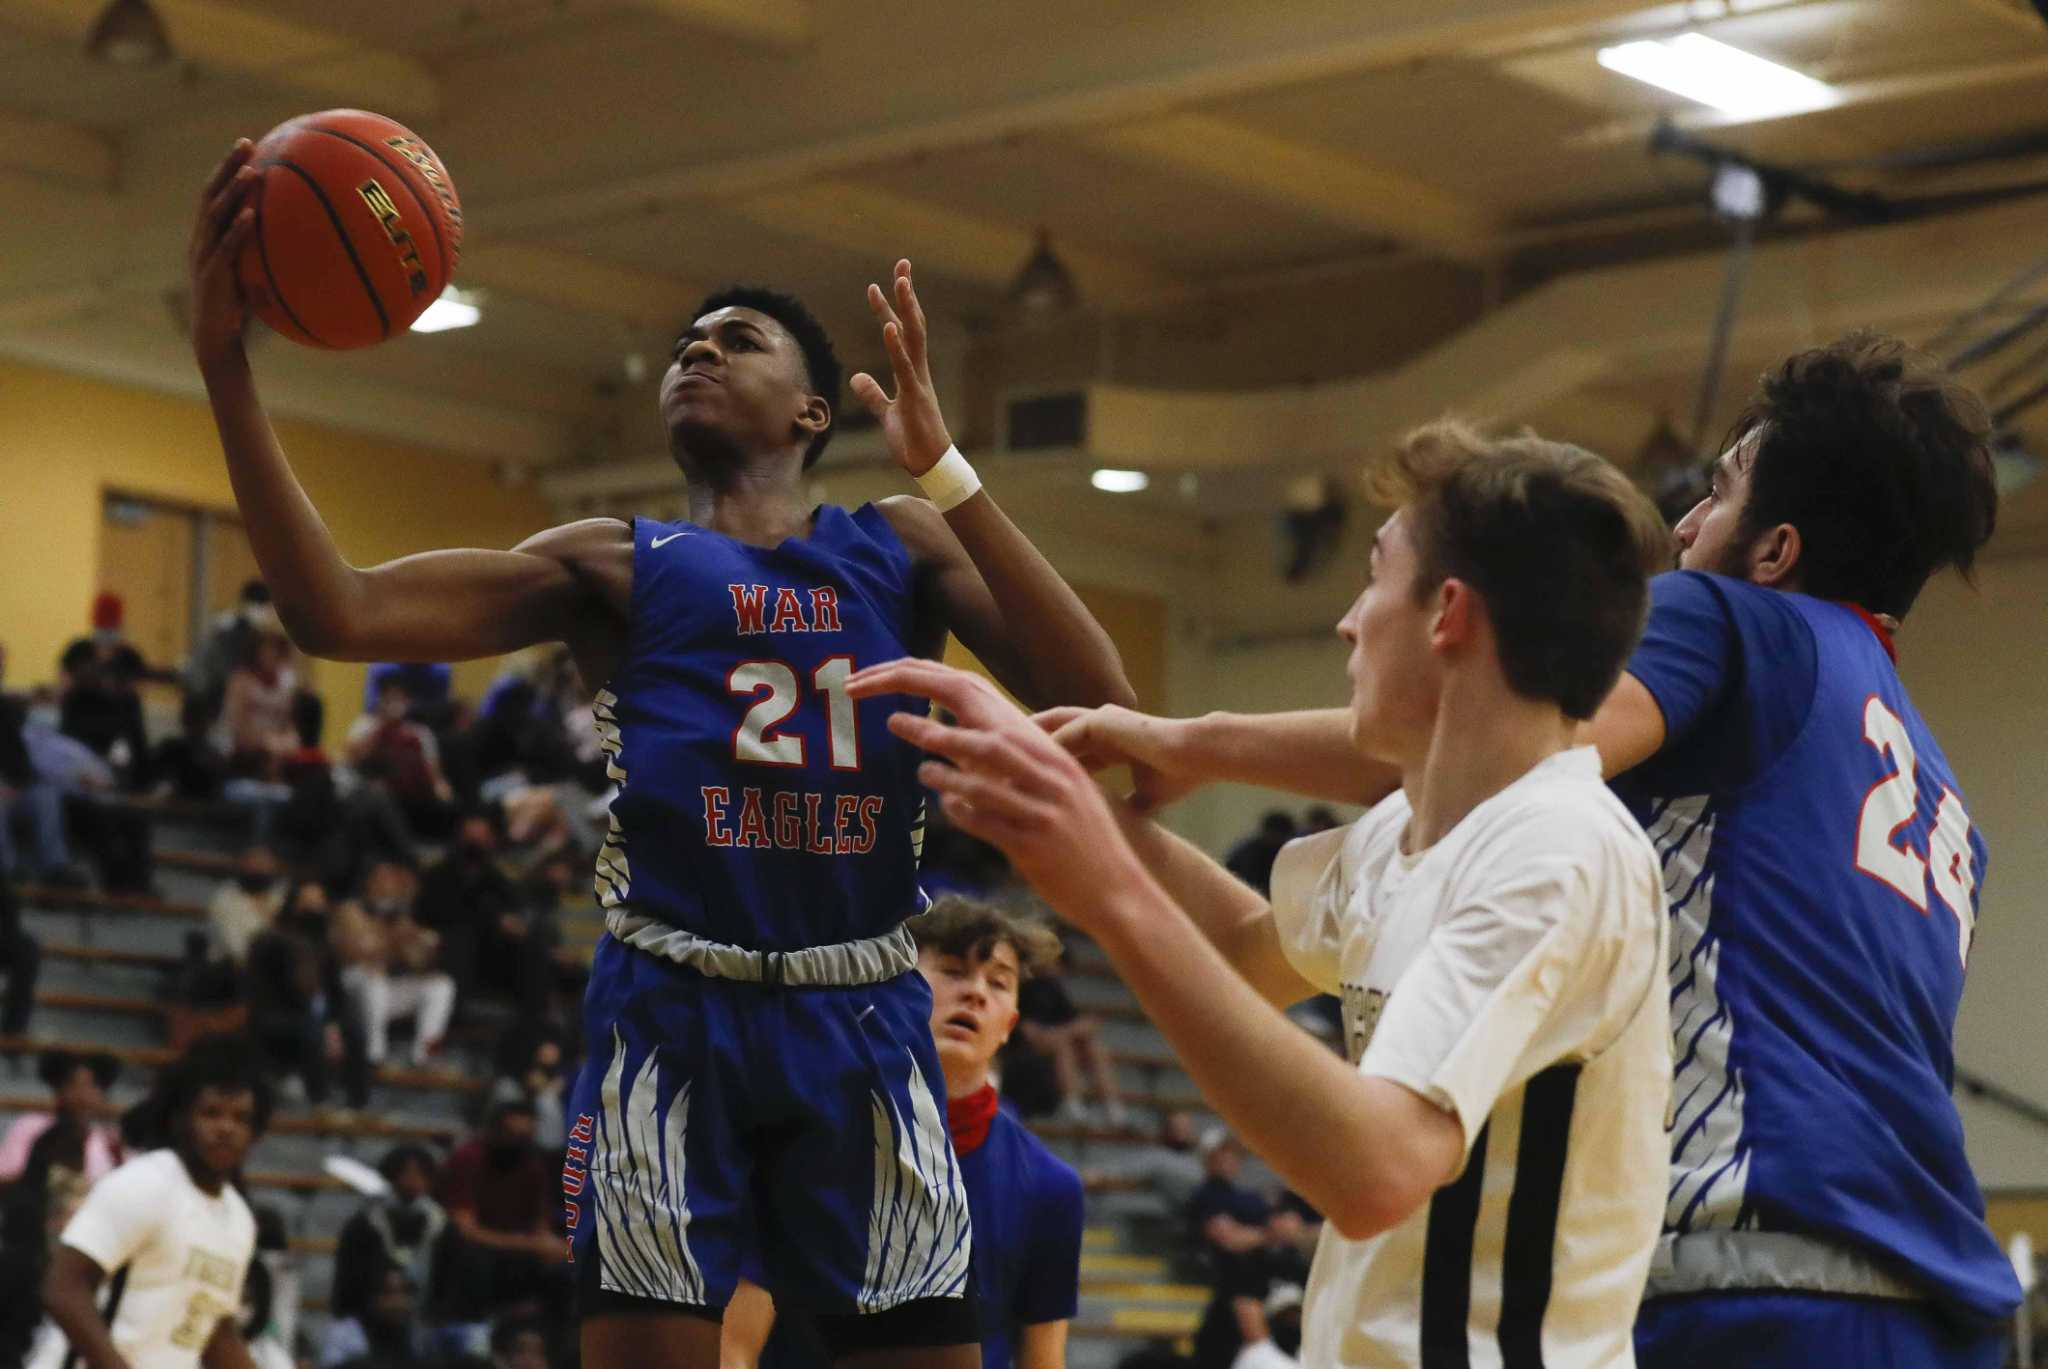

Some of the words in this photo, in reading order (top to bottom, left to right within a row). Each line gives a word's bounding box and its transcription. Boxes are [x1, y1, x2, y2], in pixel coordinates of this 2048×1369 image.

[728, 583, 842, 635] WAR
[726, 653, 860, 772] 21
[701, 785, 883, 855] EAGLES
[1853, 692, 1976, 973] 24
